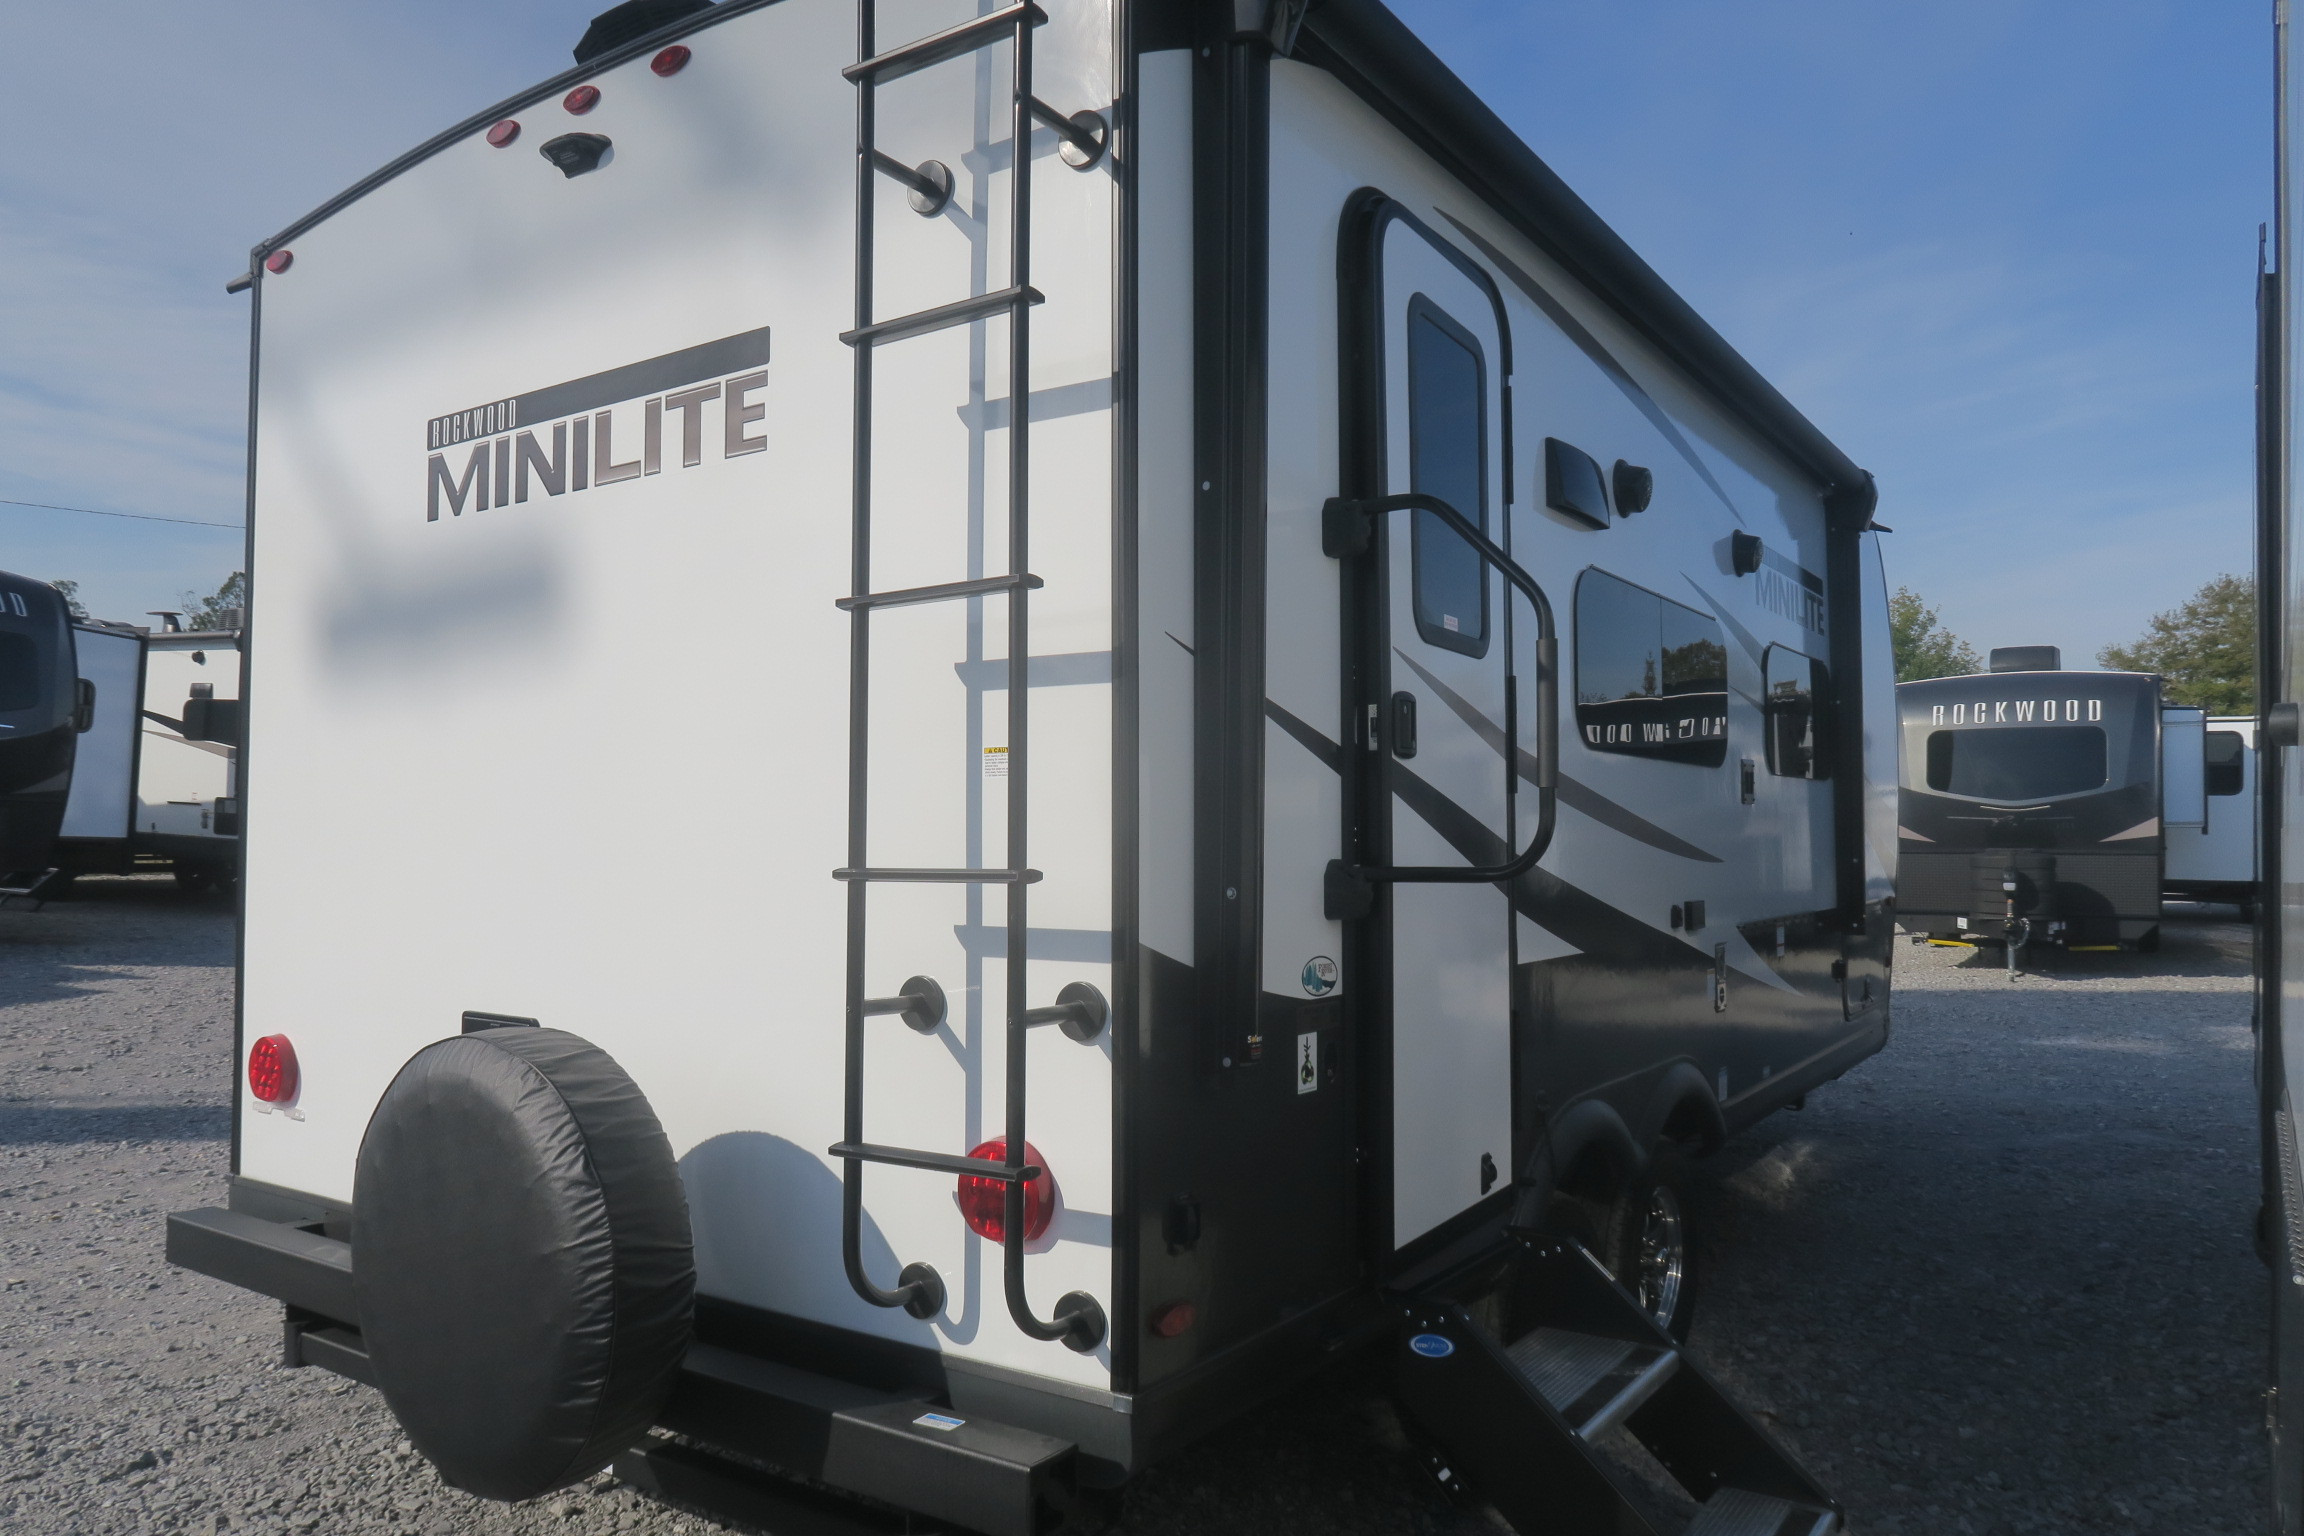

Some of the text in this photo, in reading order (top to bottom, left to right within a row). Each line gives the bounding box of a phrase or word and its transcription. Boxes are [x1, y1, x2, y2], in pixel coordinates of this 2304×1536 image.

[427, 369, 769, 523] MINILITE
[432, 399, 517, 448] ROCKWOOD
[1755, 569, 1824, 636] MINILITE
[1932, 698, 2103, 726] ROCKWOOD
